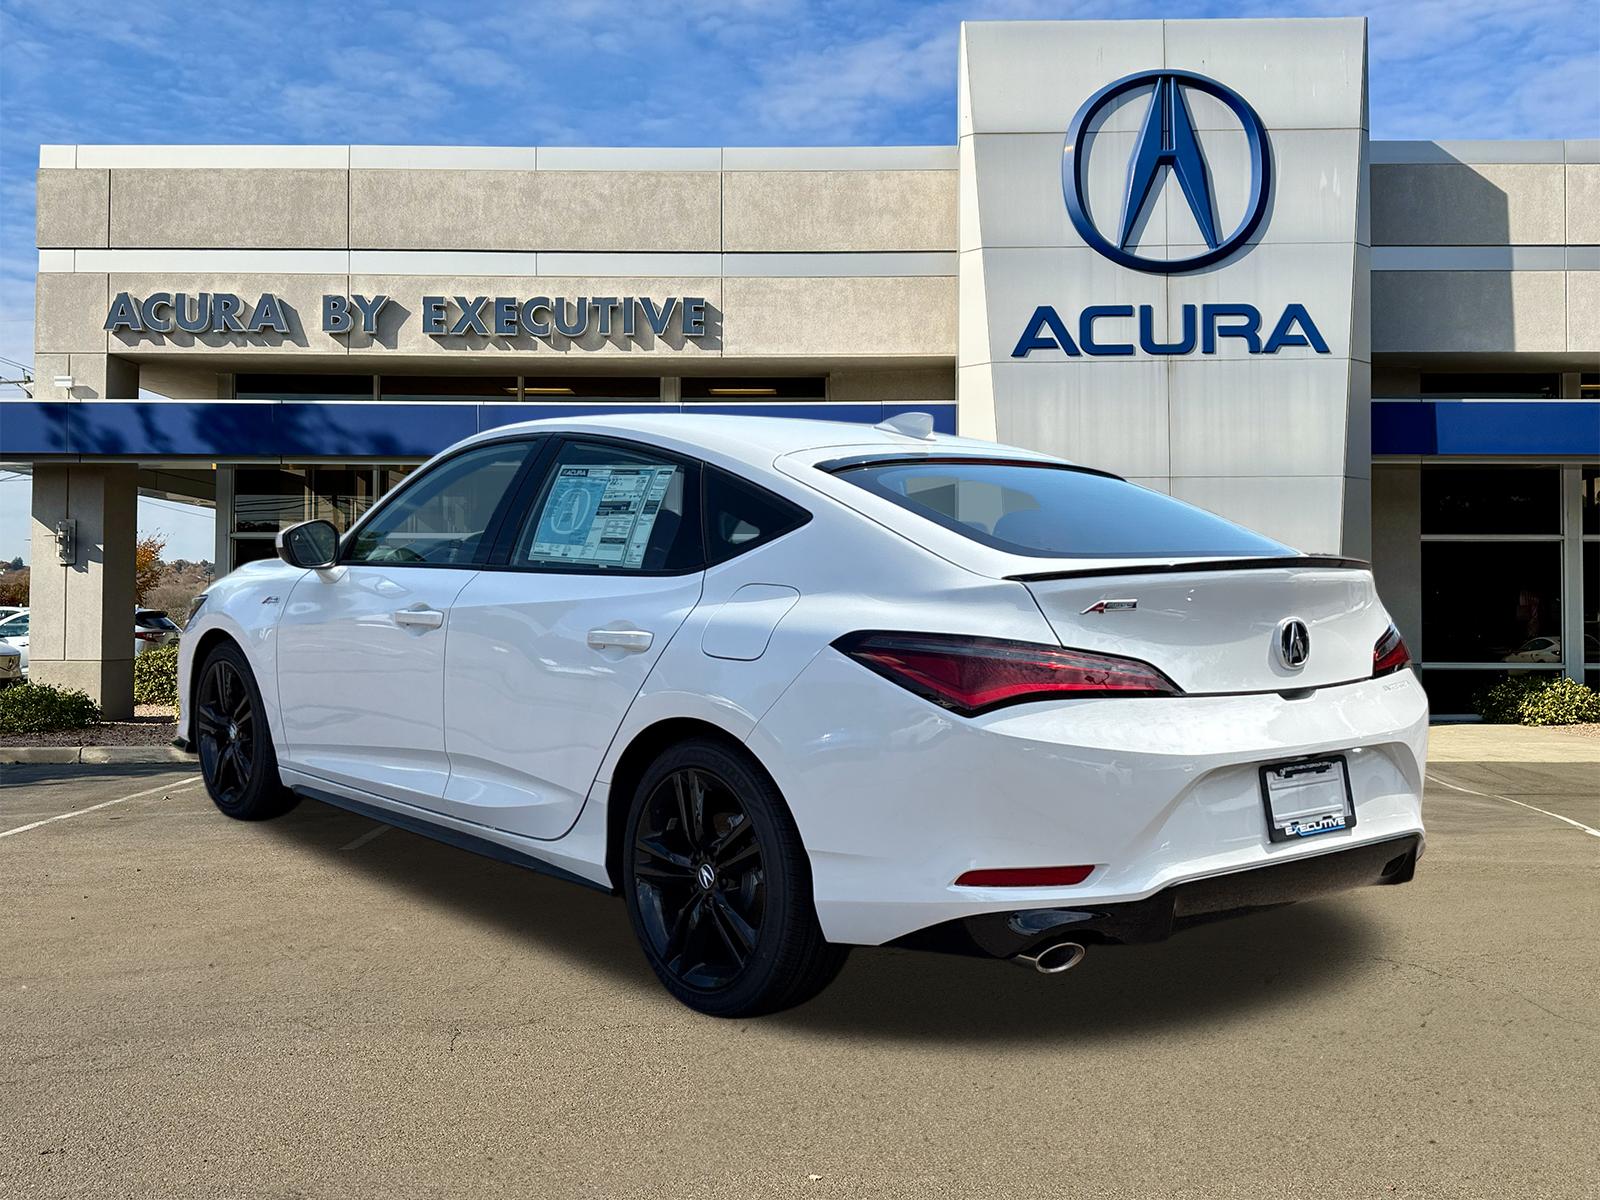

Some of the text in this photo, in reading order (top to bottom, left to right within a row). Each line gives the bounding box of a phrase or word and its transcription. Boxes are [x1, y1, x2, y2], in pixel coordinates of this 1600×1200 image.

[104, 292, 707, 337] ACURA BY EXECUTIVE
[1011, 303, 1331, 357] ACURA
[1285, 817, 1345, 835] EXECUTIVE
